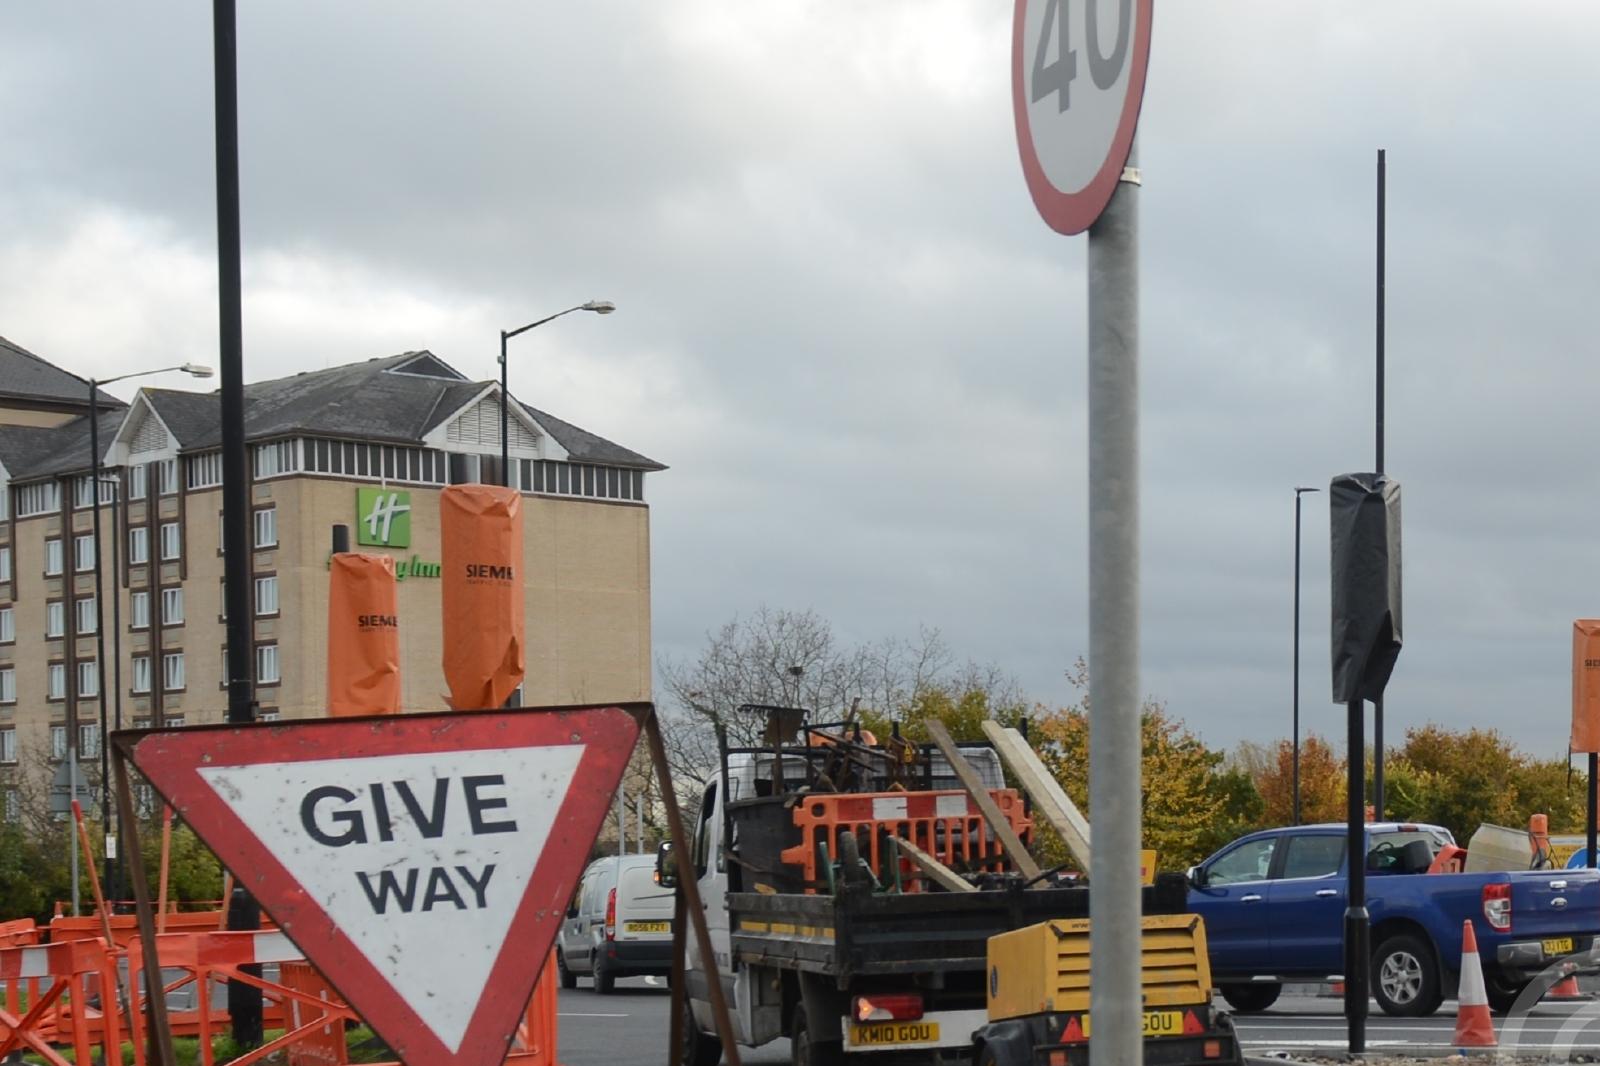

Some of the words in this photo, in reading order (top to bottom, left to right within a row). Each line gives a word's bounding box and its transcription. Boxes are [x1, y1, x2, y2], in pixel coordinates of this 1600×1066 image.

[1031, 0, 1132, 114] 40
[301, 774, 518, 847] GIVE
[355, 864, 496, 914] WAY
[859, 1026, 895, 1043] KM10
[899, 1025, 930, 1041] GOU
